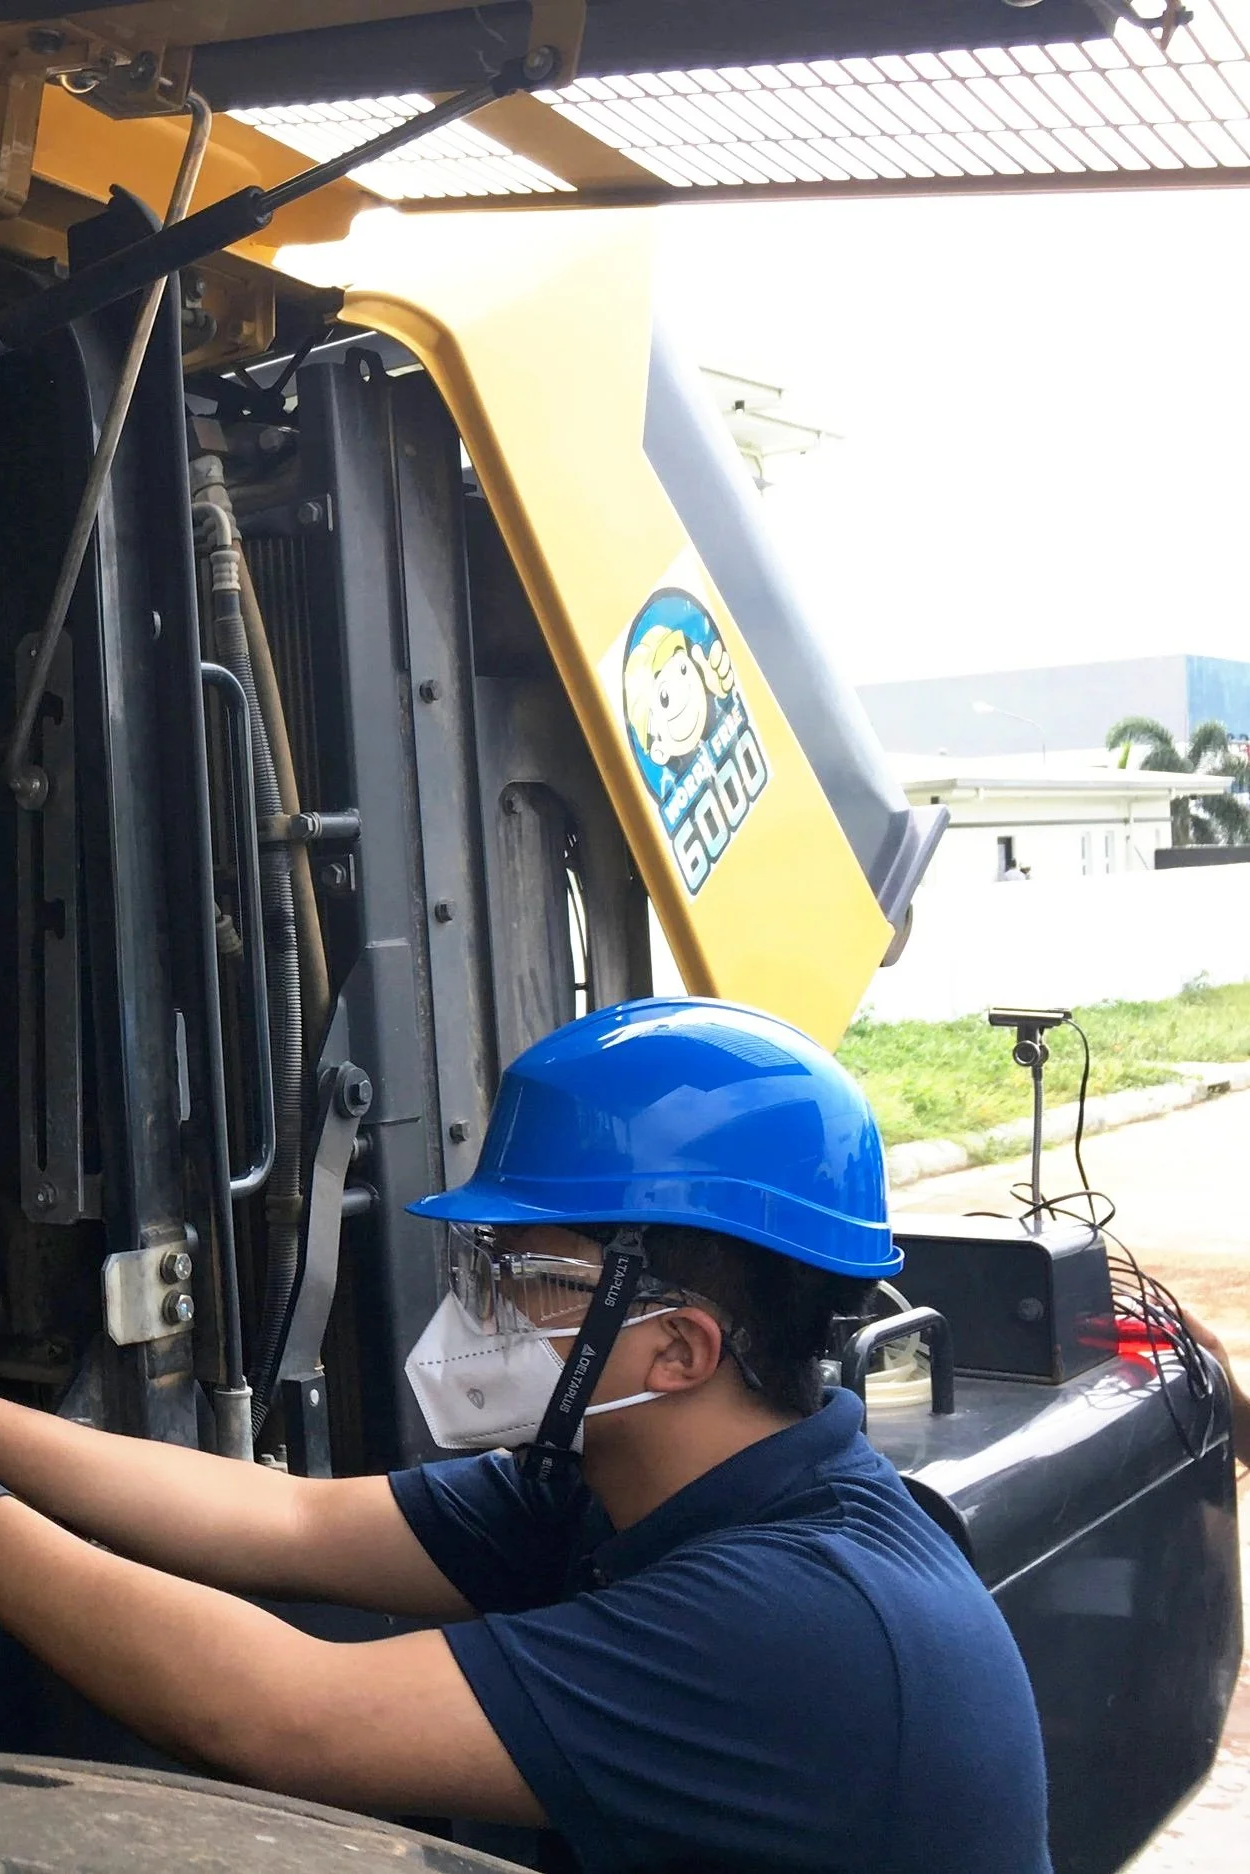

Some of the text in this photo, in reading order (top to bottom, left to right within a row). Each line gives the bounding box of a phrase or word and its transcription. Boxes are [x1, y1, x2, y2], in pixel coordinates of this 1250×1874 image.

[664, 747, 715, 825] WORRY
[672, 728, 767, 893] 6000
[604, 1255, 629, 1307] LTAPLUS
[559, 1357, 591, 1413] DELTAPLUS
